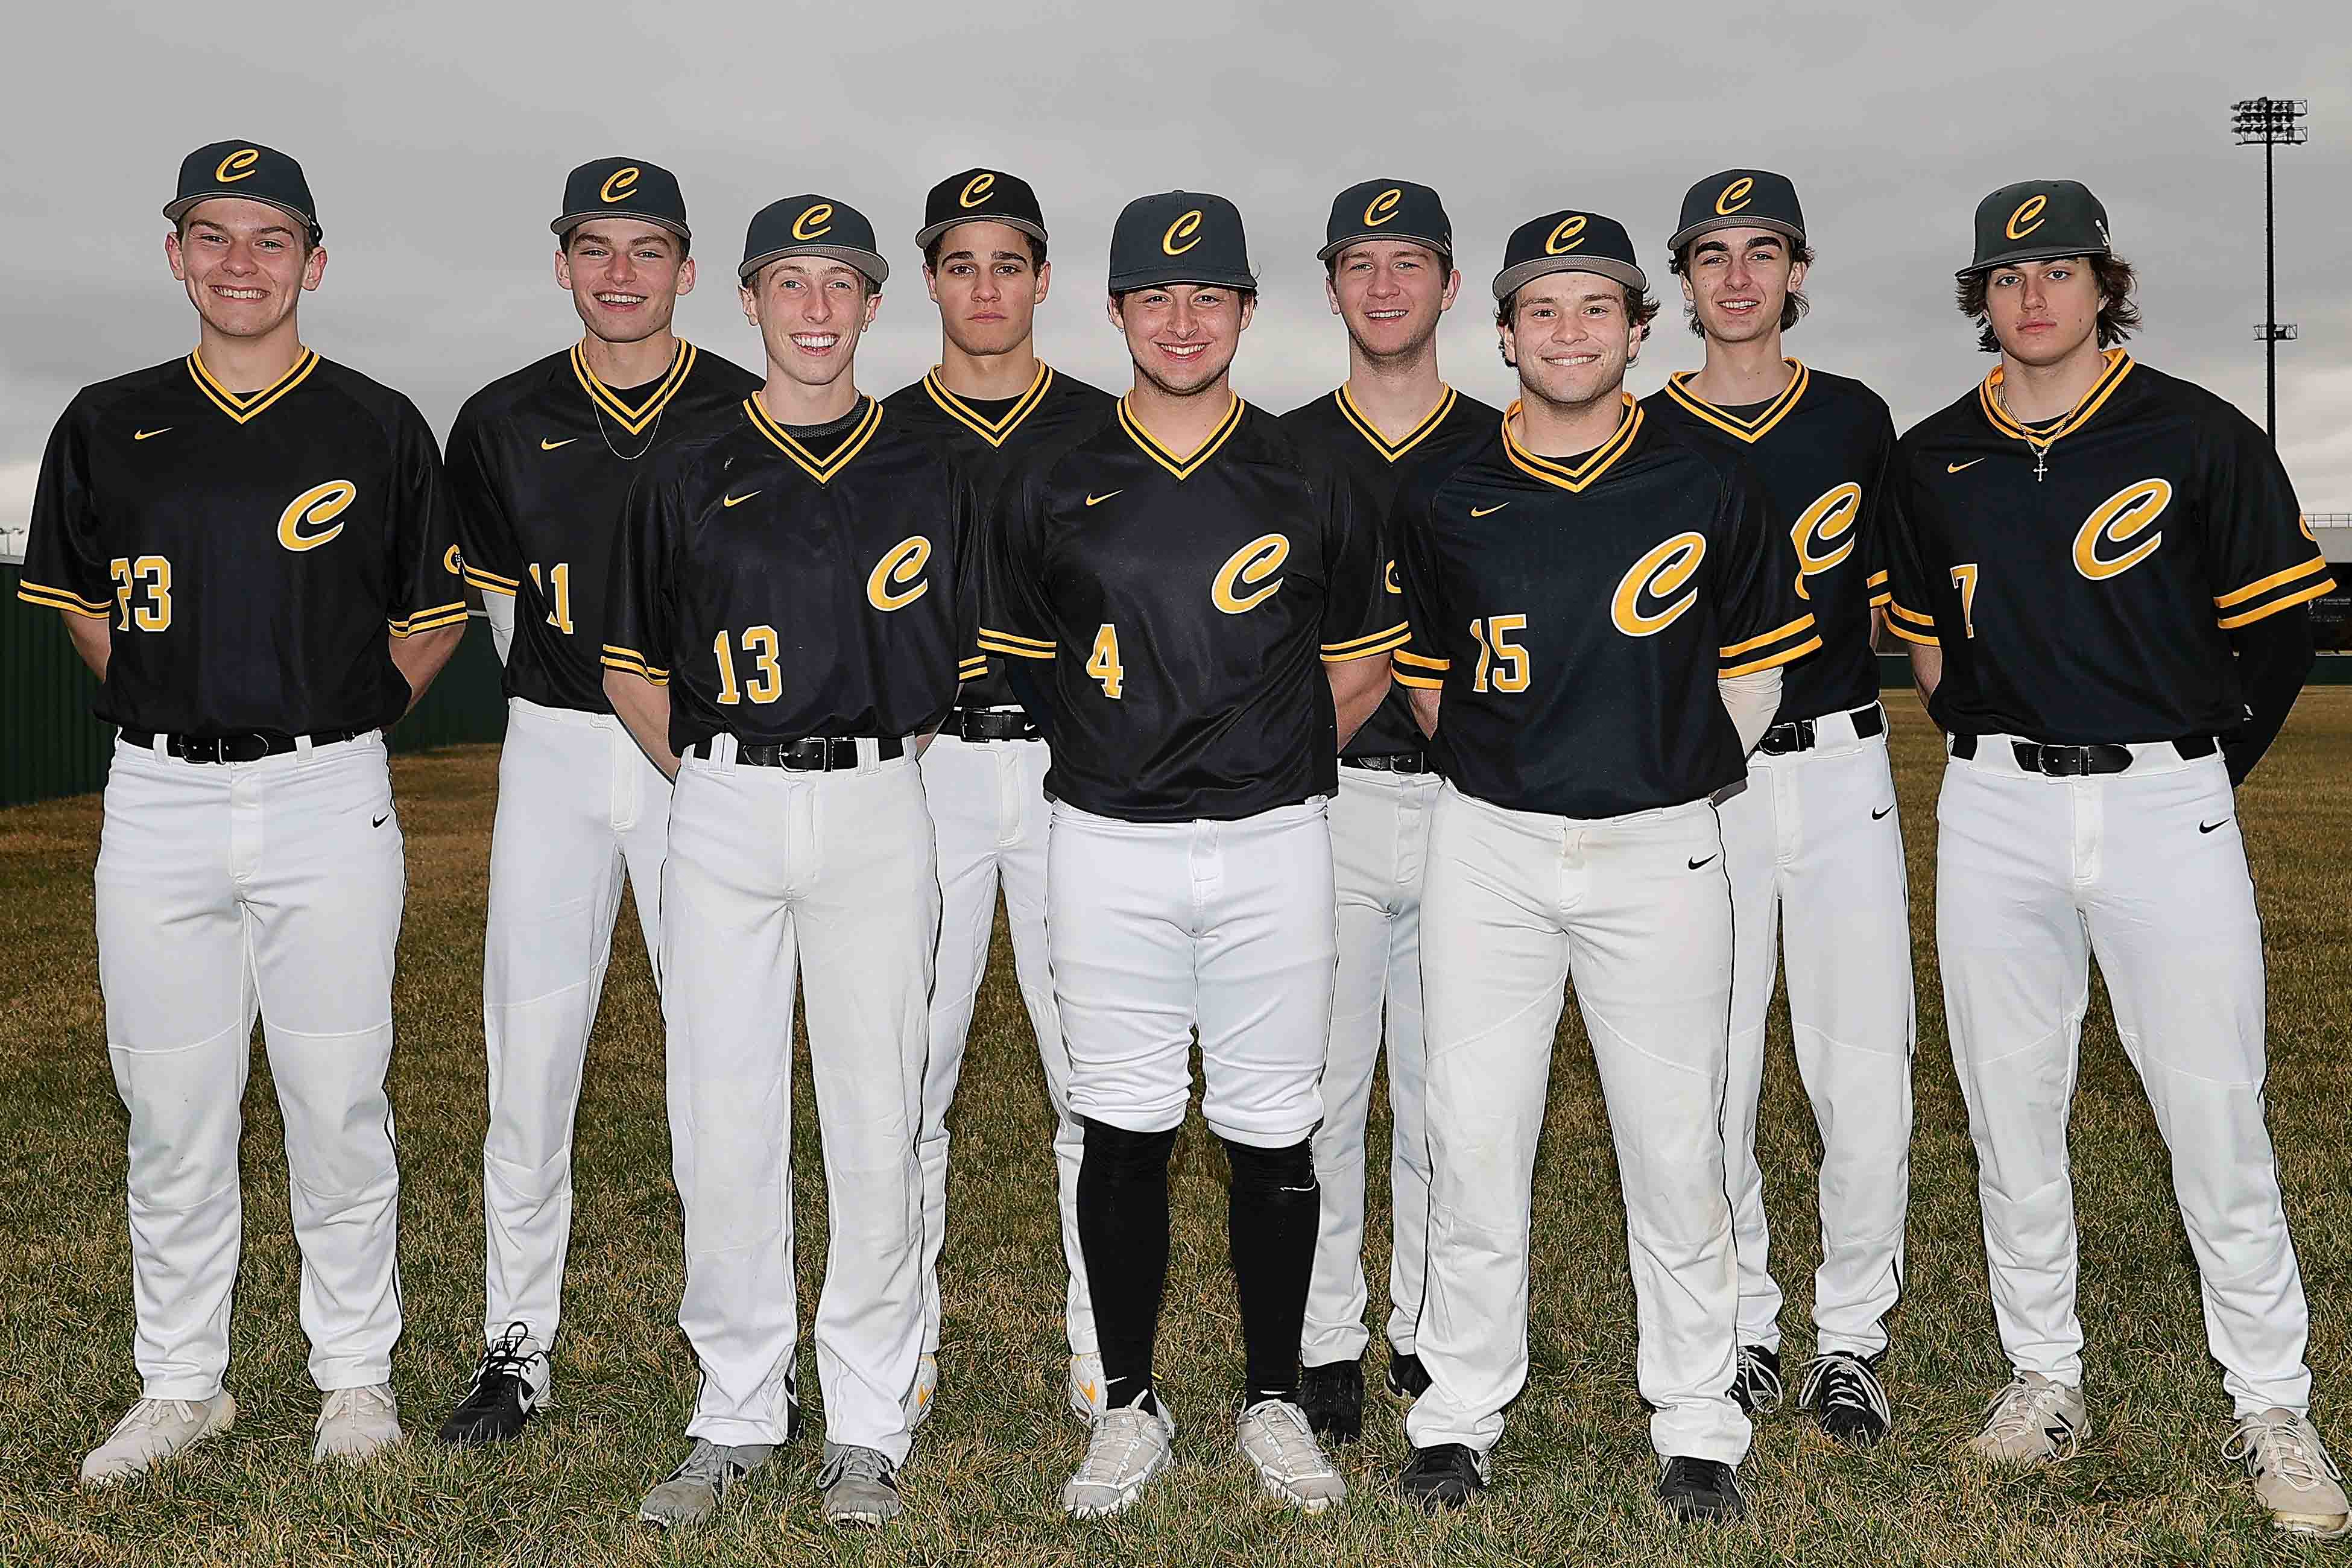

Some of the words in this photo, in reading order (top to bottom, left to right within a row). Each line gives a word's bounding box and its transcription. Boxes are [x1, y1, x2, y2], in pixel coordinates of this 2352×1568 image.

[215, 149, 260, 183] C
[599, 168, 640, 203] C
[959, 174, 995, 207] C
[1714, 177, 1754, 217] C
[791, 203, 833, 241] C
[1162, 210, 1203, 256] C
[1363, 189, 1402, 227] C
[1544, 215, 1588, 255] C
[2005, 194, 2048, 240] C
[277, 479, 356, 551] C
[1789, 482, 1862, 576] C
[2072, 478, 2172, 581] C
[110, 555, 171, 632] 23
[866, 535, 932, 612] C
[1210, 533, 1290, 615] C
[1610, 531, 1707, 637] C
[1950, 563, 1979, 639] 7
[713, 624, 783, 705] 13
[1086, 622, 1124, 700] 4
[1469, 613, 1531, 694] 15
